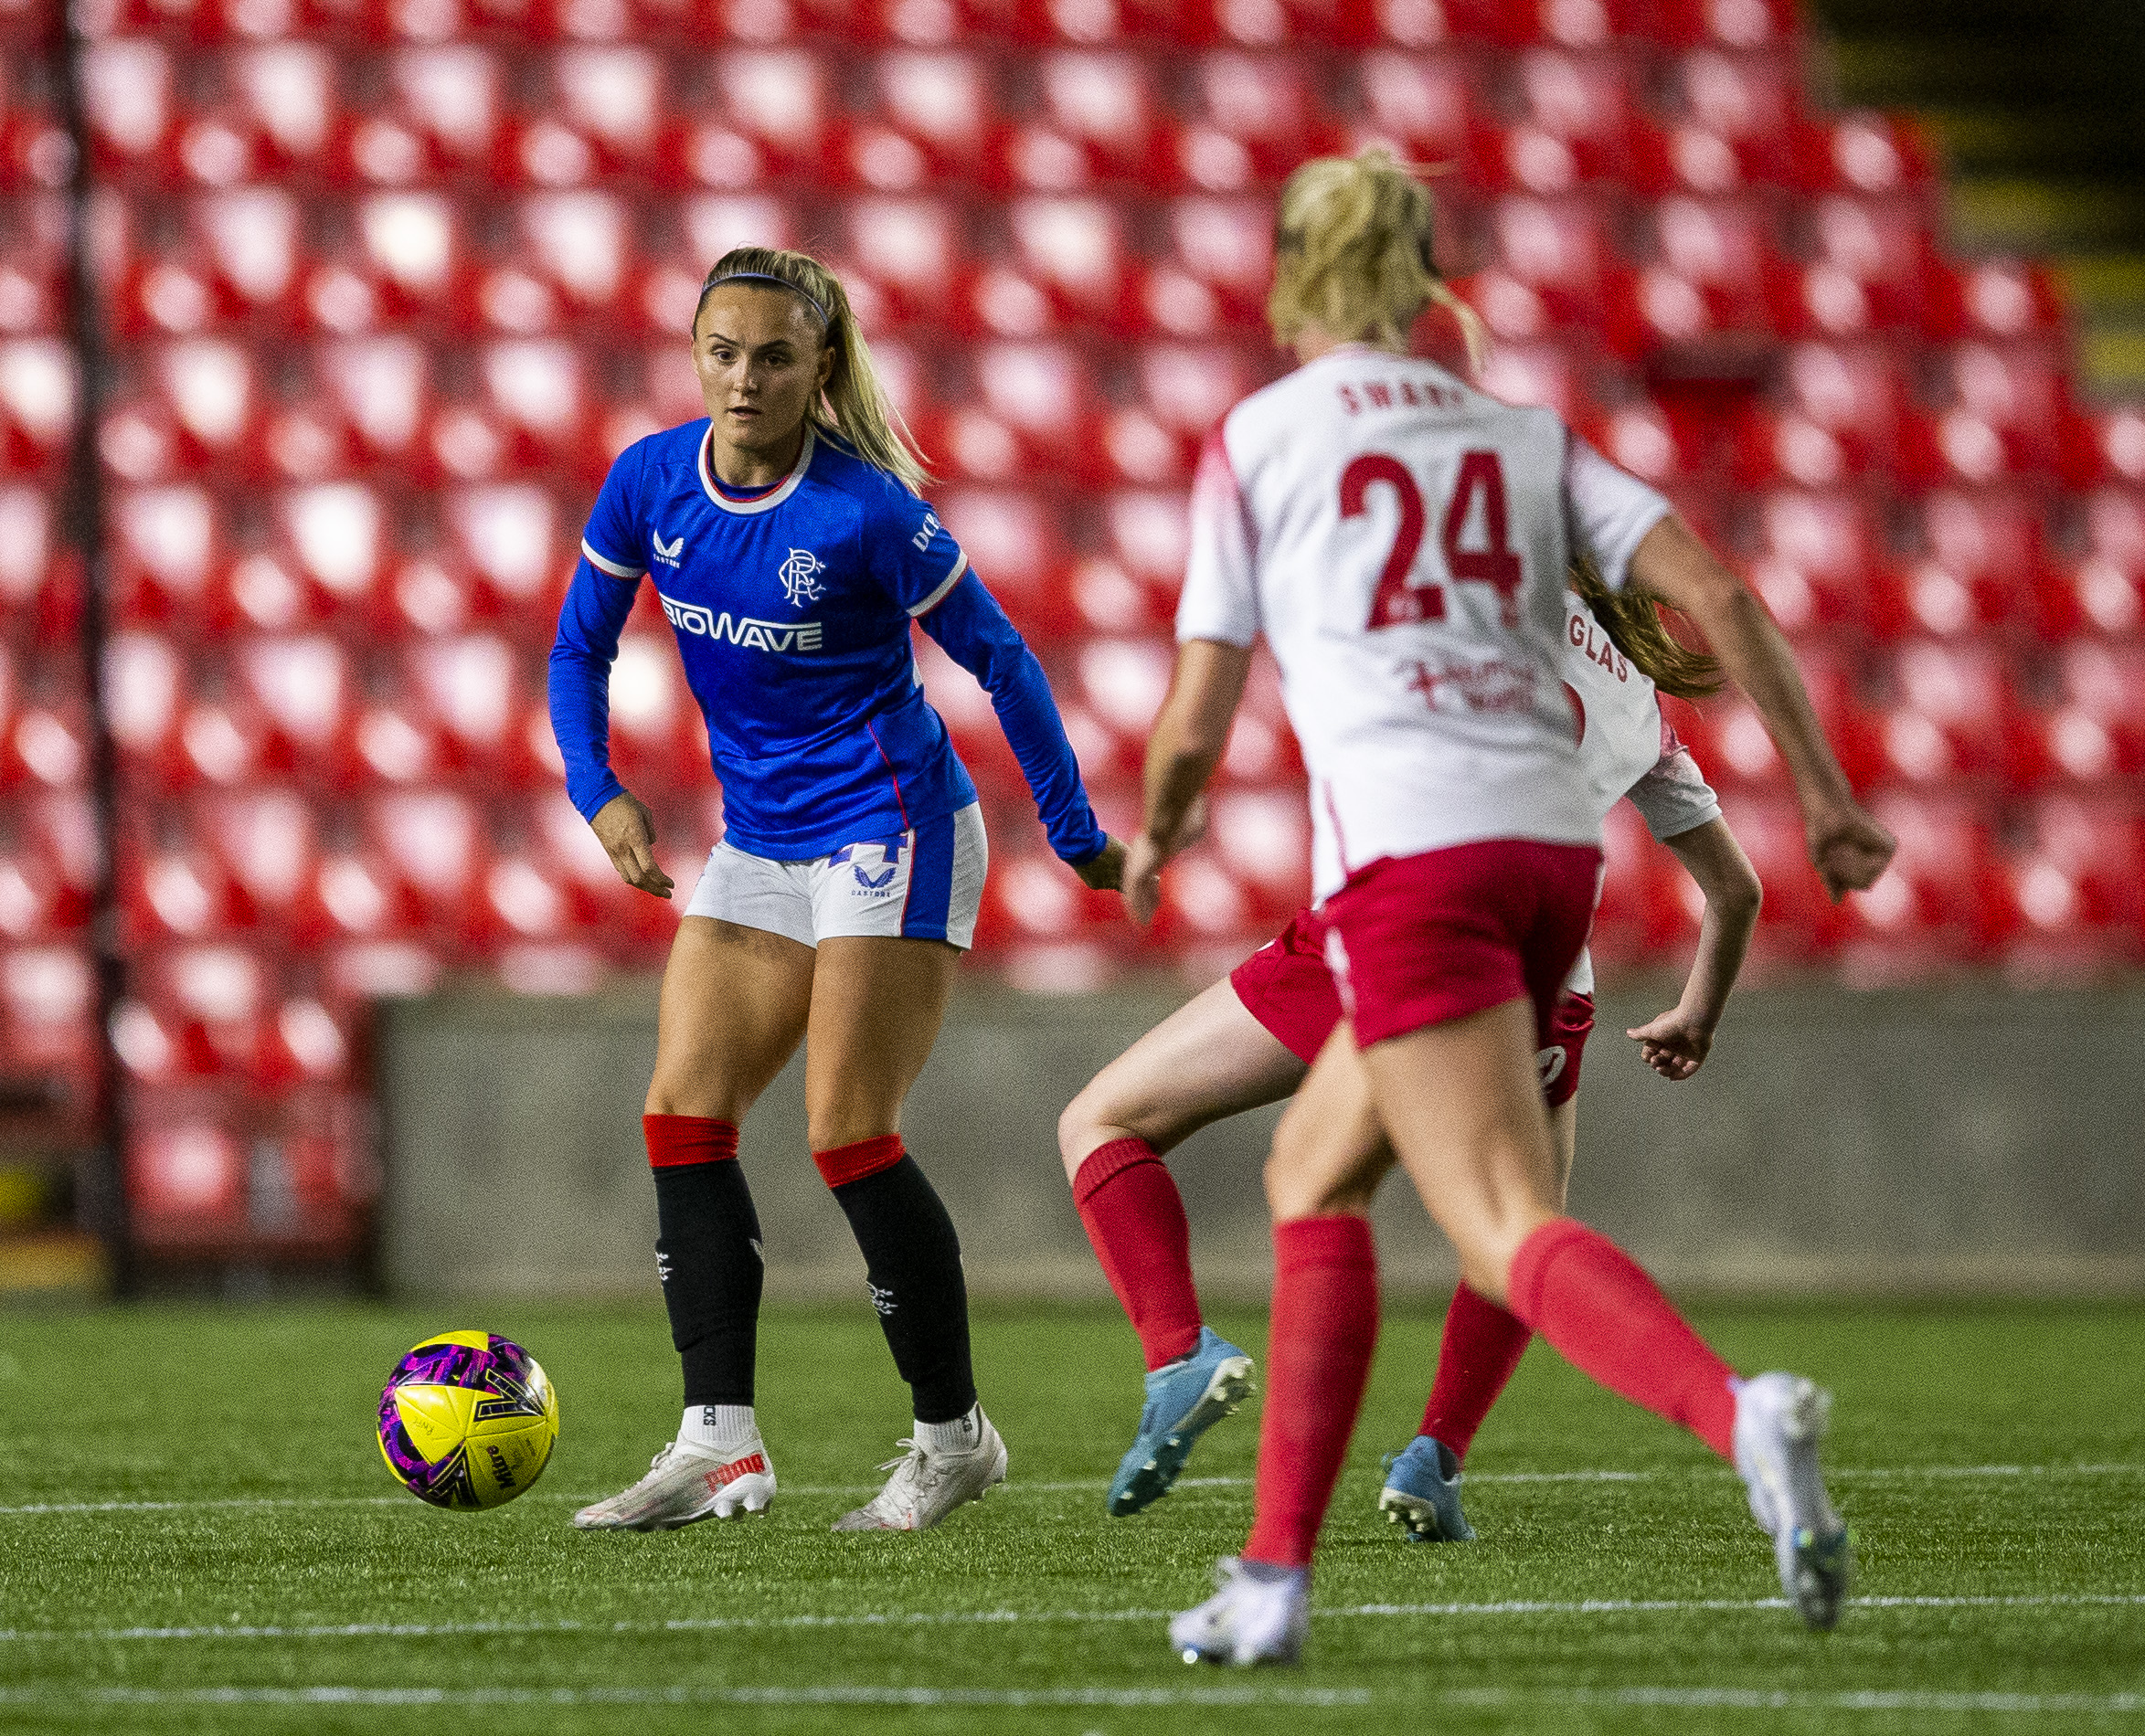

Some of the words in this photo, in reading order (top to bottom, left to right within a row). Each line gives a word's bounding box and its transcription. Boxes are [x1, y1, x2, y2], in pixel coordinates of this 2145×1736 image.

[1337, 449, 1524, 631] 24
[659, 591, 823, 652] BIOWAVE
[1569, 614, 1628, 683] GLAS
